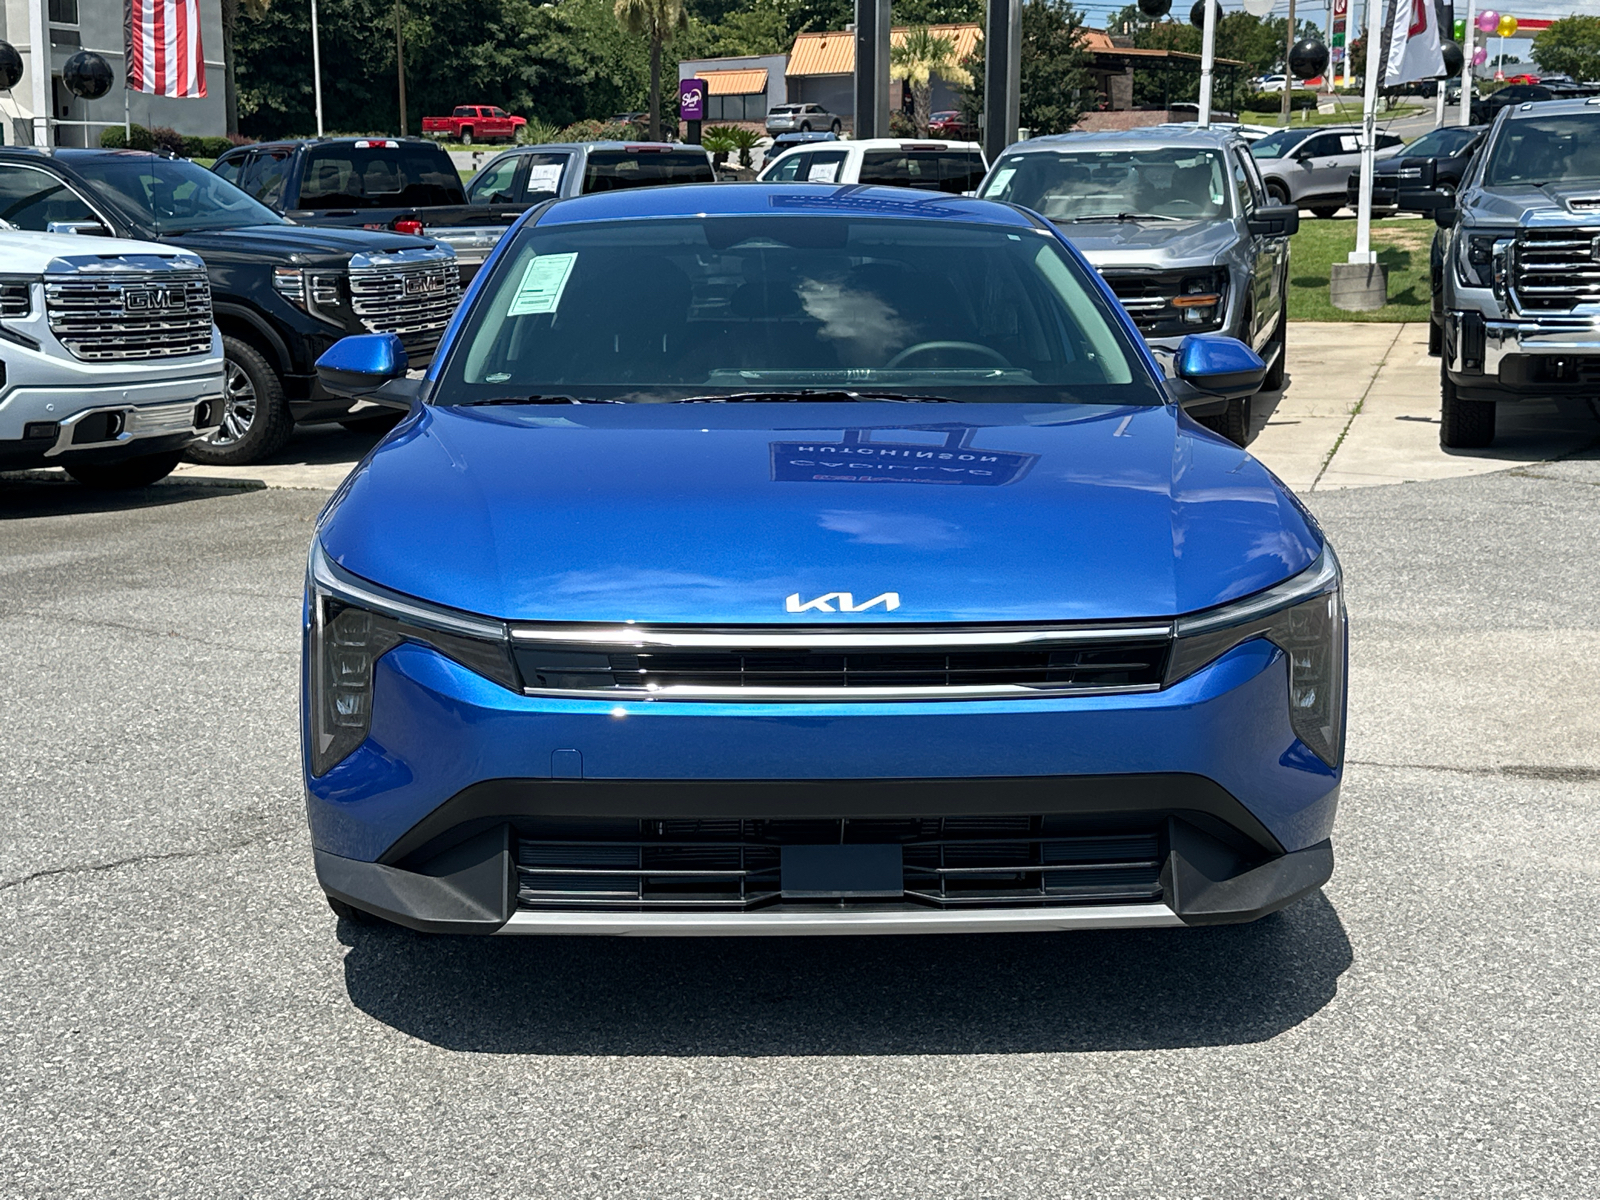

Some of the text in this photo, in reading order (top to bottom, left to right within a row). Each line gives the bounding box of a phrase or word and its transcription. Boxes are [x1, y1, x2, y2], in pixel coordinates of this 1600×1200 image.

[405, 275, 445, 294] GMC
[126, 289, 185, 310] GMC
[785, 592, 901, 614] KIA
